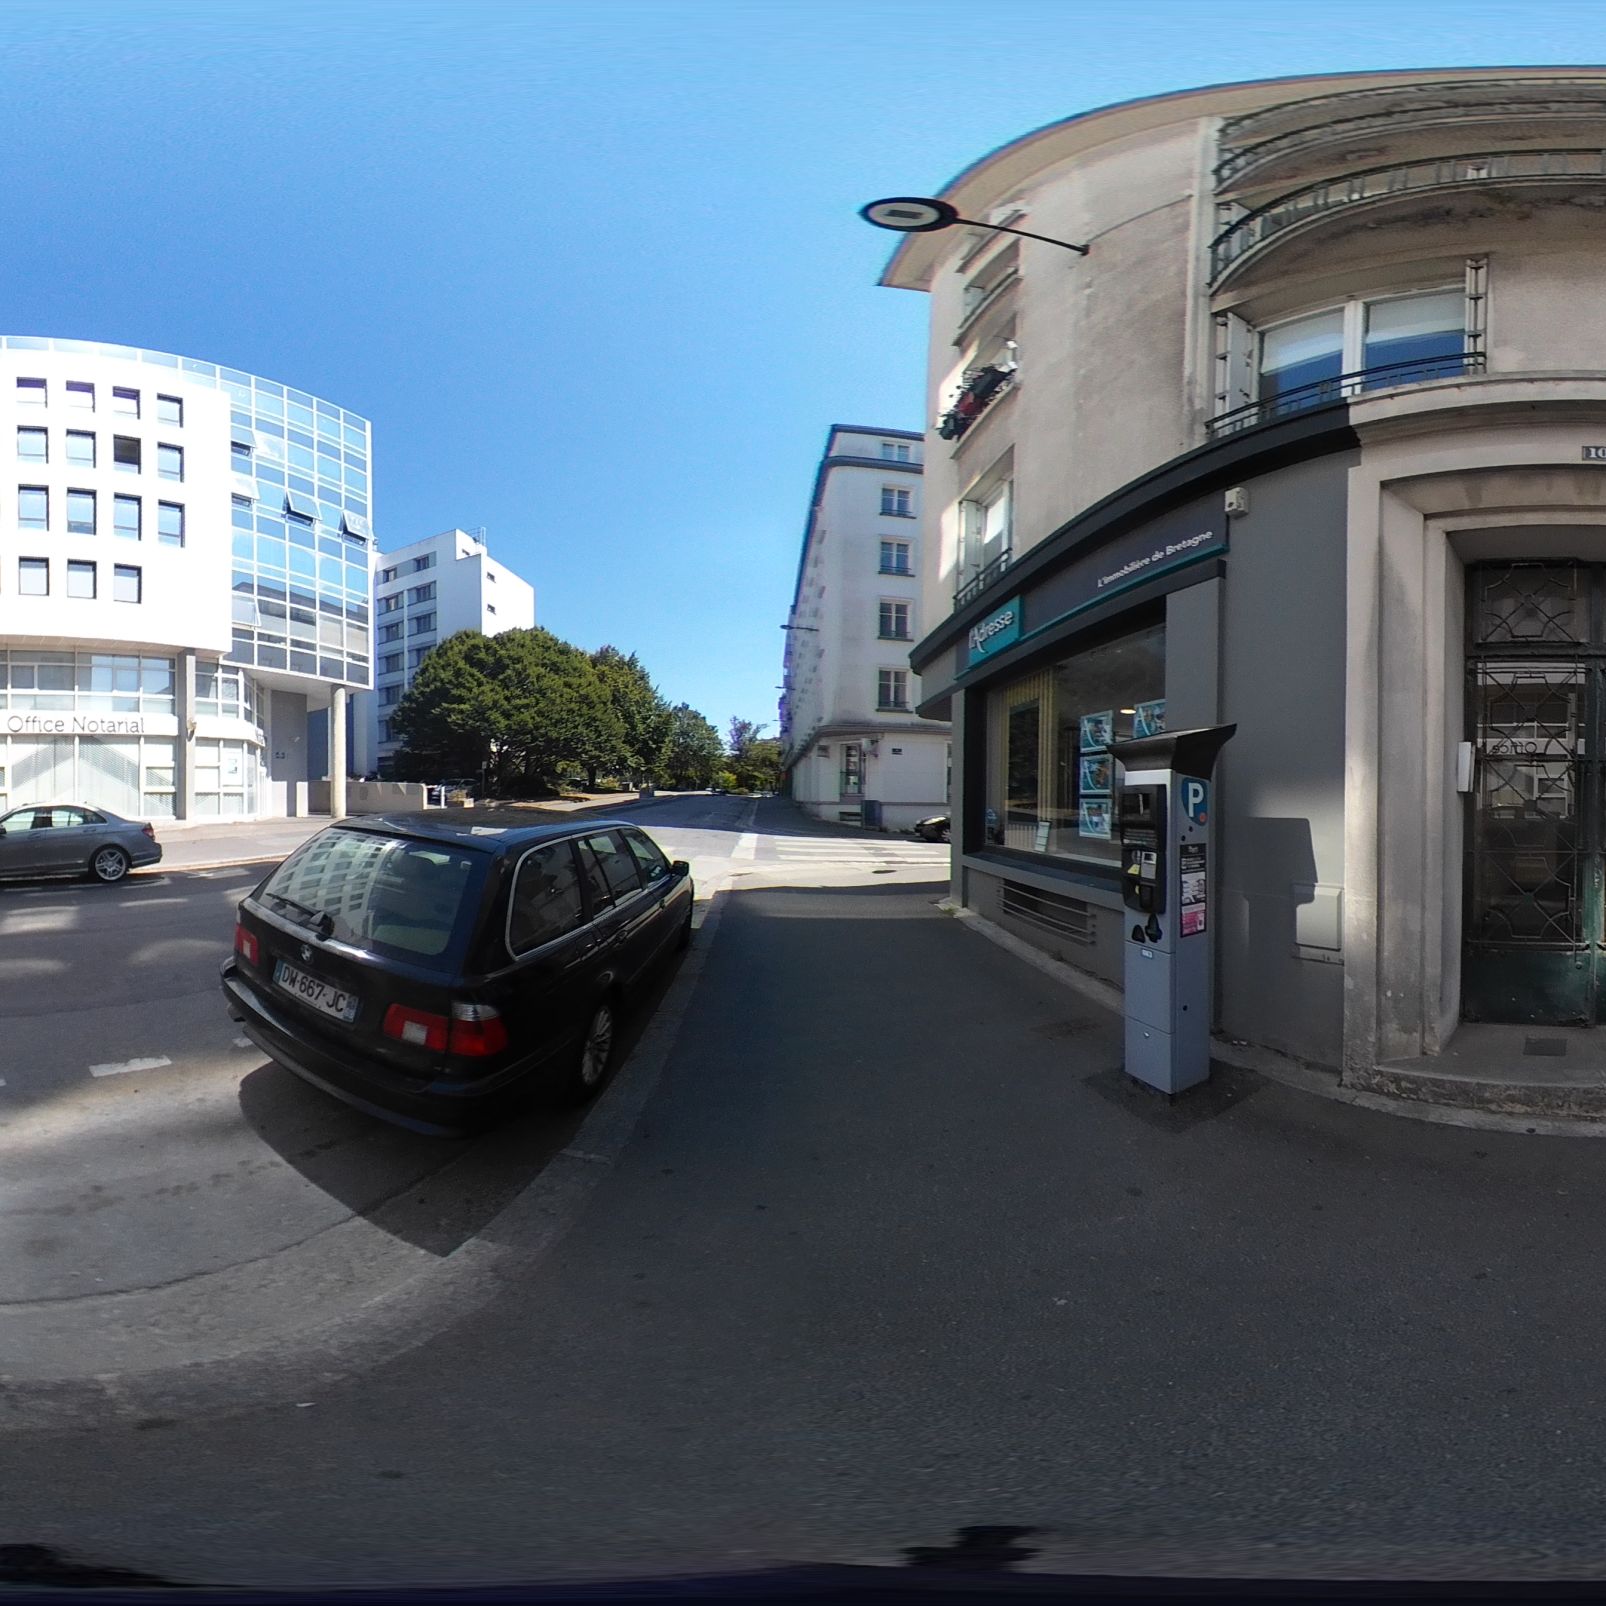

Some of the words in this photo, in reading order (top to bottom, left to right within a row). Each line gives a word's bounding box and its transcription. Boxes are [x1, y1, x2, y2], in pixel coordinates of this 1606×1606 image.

[1165, 531, 1213, 556] Bretagne
[7, 715, 65, 733] Office
[72, 716, 145, 733] Notarial
[1188, 782, 1204, 818] P
